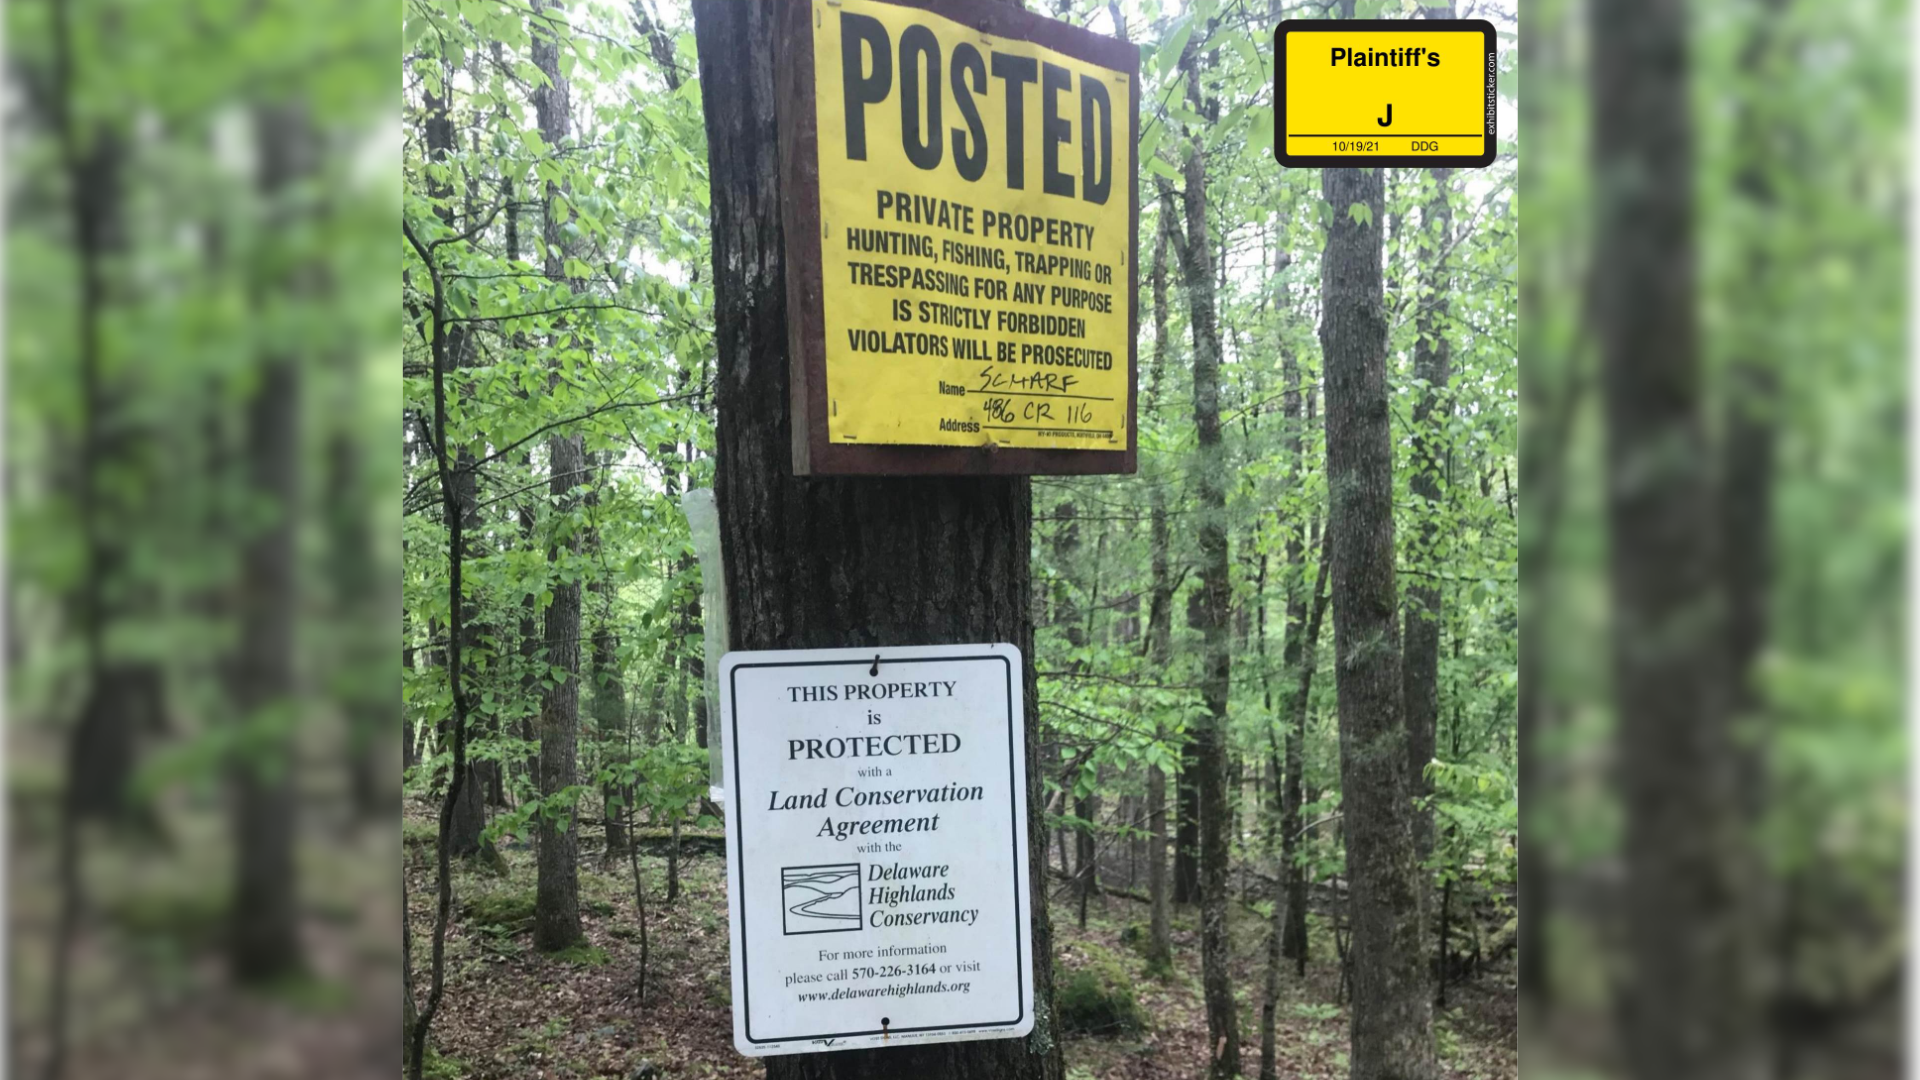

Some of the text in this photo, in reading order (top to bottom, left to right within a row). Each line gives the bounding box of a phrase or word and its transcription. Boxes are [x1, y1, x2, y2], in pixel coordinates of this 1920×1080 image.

[840, 11, 1112, 206] POSTED
[877, 190, 1095, 251] PRIVATE PROPERTY
[847, 227, 1112, 285] HUNTING, FISHING, TRAPPING OR
[847, 262, 1112, 314] TRESPASSING FOR ANY PURPOSE
[893, 299, 1085, 339] IS STRICTLY FORBIDDEN
[848, 329, 1112, 371] VIOLATORS WILL BE PROSECUTED
[939, 380, 965, 396] Name
[1024, 401, 1055, 423] CR
[1067, 402, 1092, 424] 116
[939, 418, 980, 433] Address
[787, 680, 957, 702] THIS PROPERTY
[867, 709, 881, 725] is
[788, 733, 961, 760] PROTECTED
[857, 766, 892, 778] with a
[768, 782, 984, 811] Land Conservation
[816, 813, 940, 841] Agreement
[857, 841, 902, 854] with the
[868, 862, 949, 881] Delaware
[868, 883, 956, 907] Highlands
[870, 907, 979, 928] Conservancy
[819, 943, 947, 962] For more information
[785, 961, 981, 987] please call 570-226-3164 or visit
[798, 981, 971, 1002] www.delawarehighlands.org
